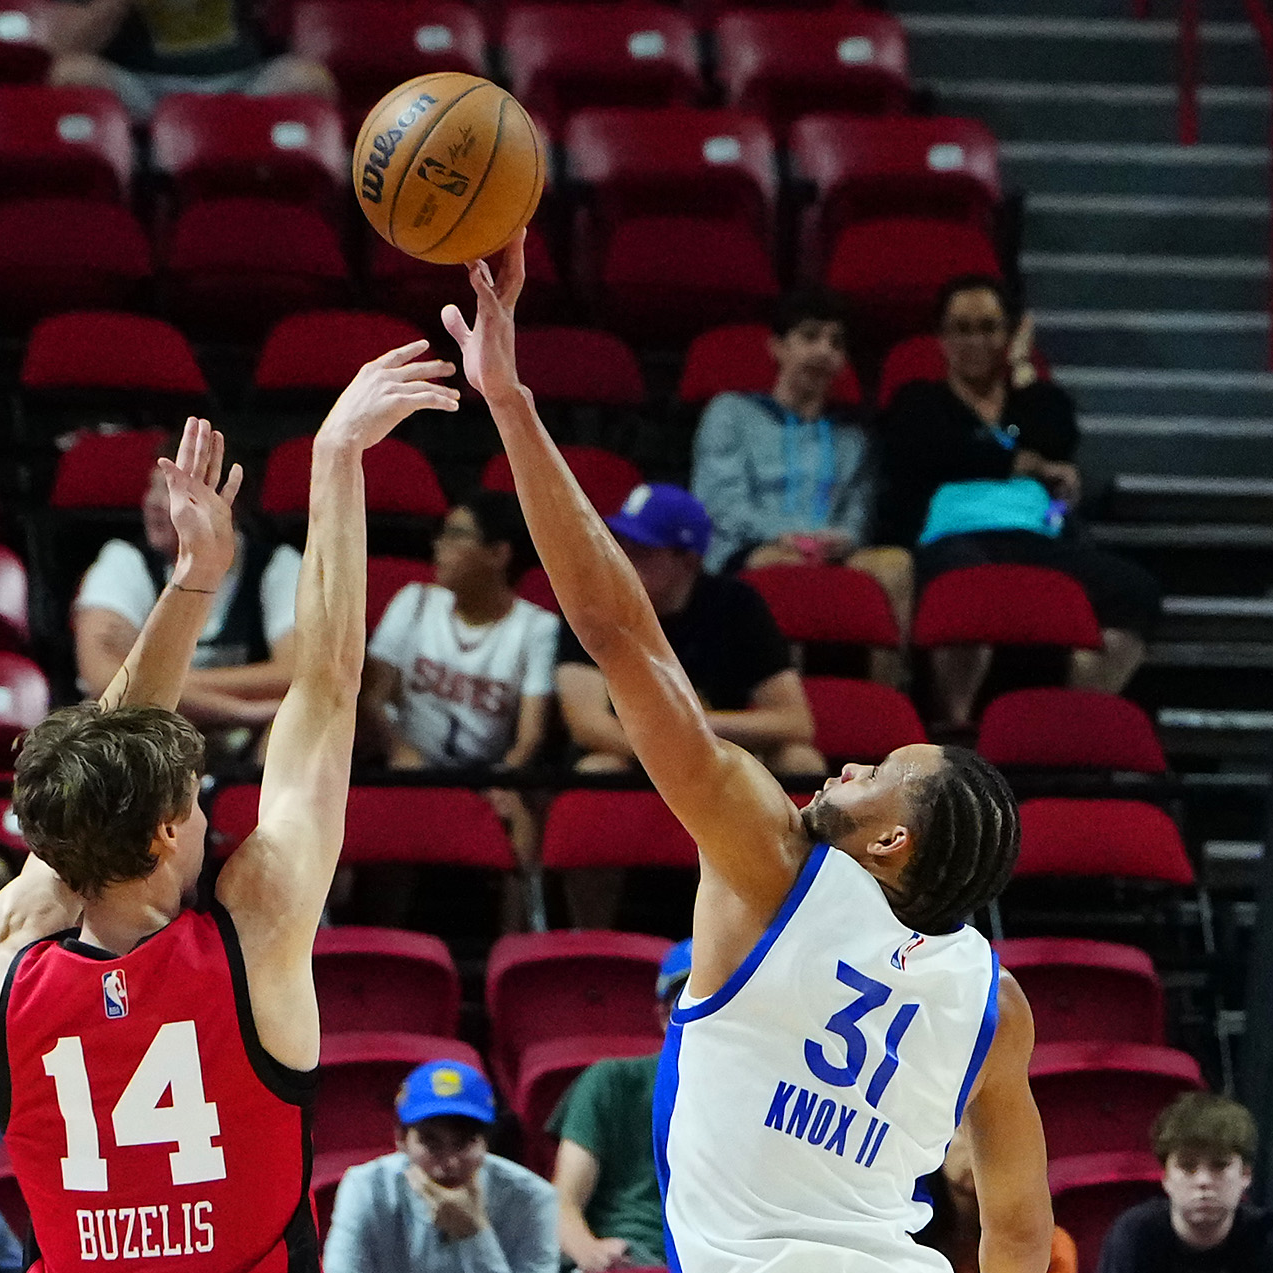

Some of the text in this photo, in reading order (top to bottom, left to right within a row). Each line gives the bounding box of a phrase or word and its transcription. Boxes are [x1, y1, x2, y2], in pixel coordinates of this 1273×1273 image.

[803, 959, 921, 1110] 31
[41, 1019, 227, 1192] 14
[764, 1080, 858, 1157] KNOX
[76, 1200, 215, 1261] BUZELIS
